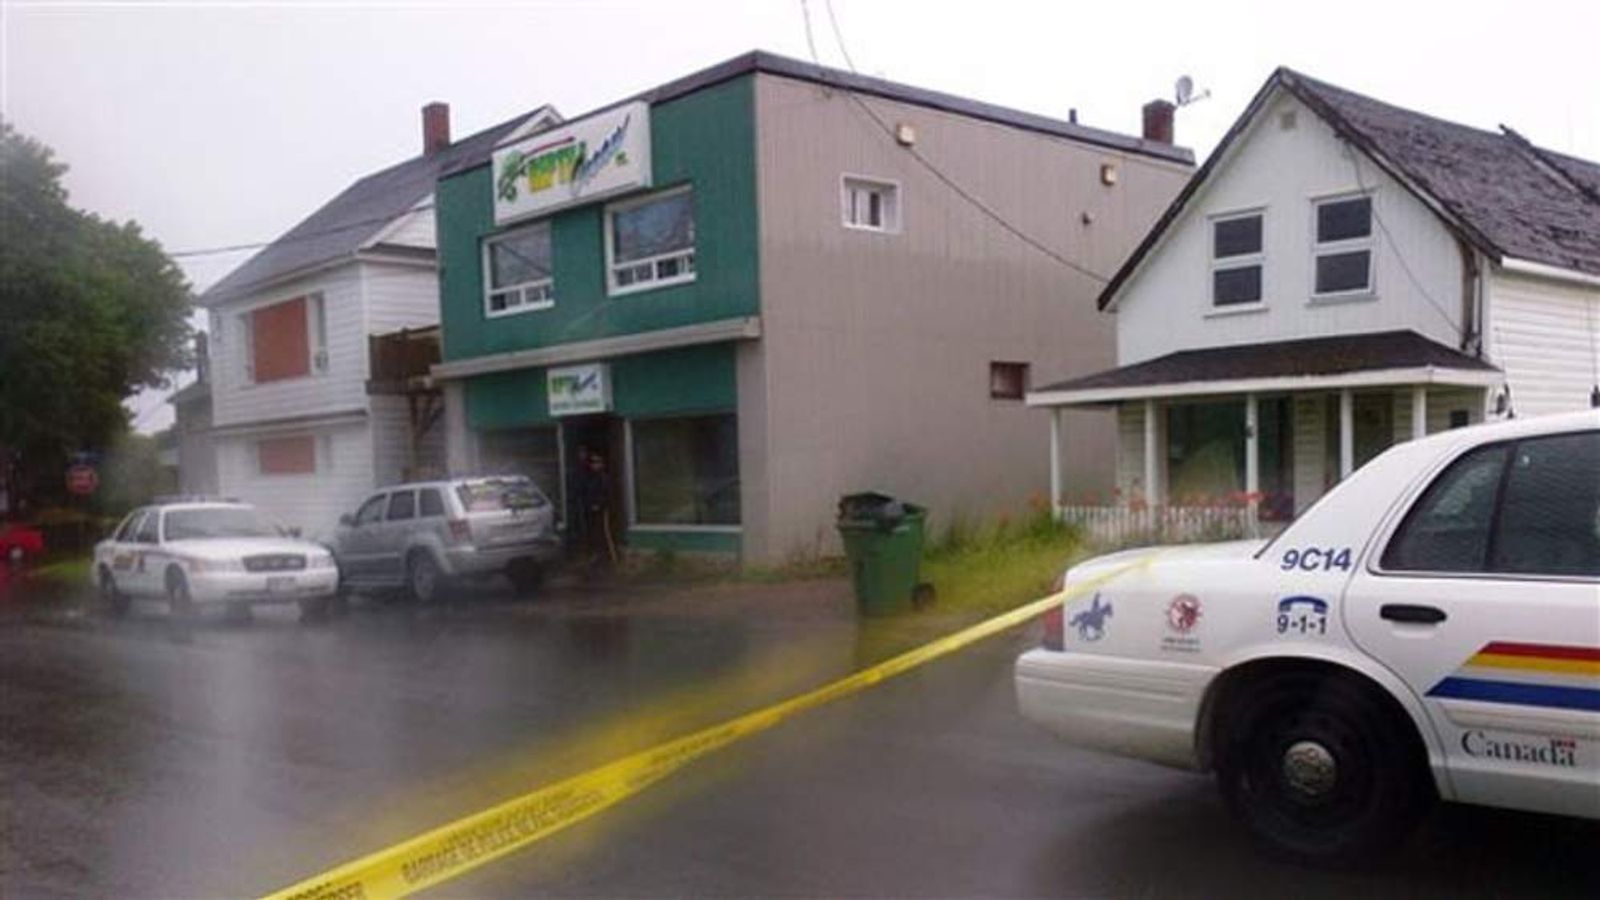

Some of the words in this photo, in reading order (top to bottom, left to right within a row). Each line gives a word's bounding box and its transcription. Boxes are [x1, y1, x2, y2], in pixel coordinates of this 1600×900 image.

[1280, 547, 1351, 571] 9C14
[1277, 614, 1327, 635] 9-1-1
[1461, 730, 1576, 766] Canada
